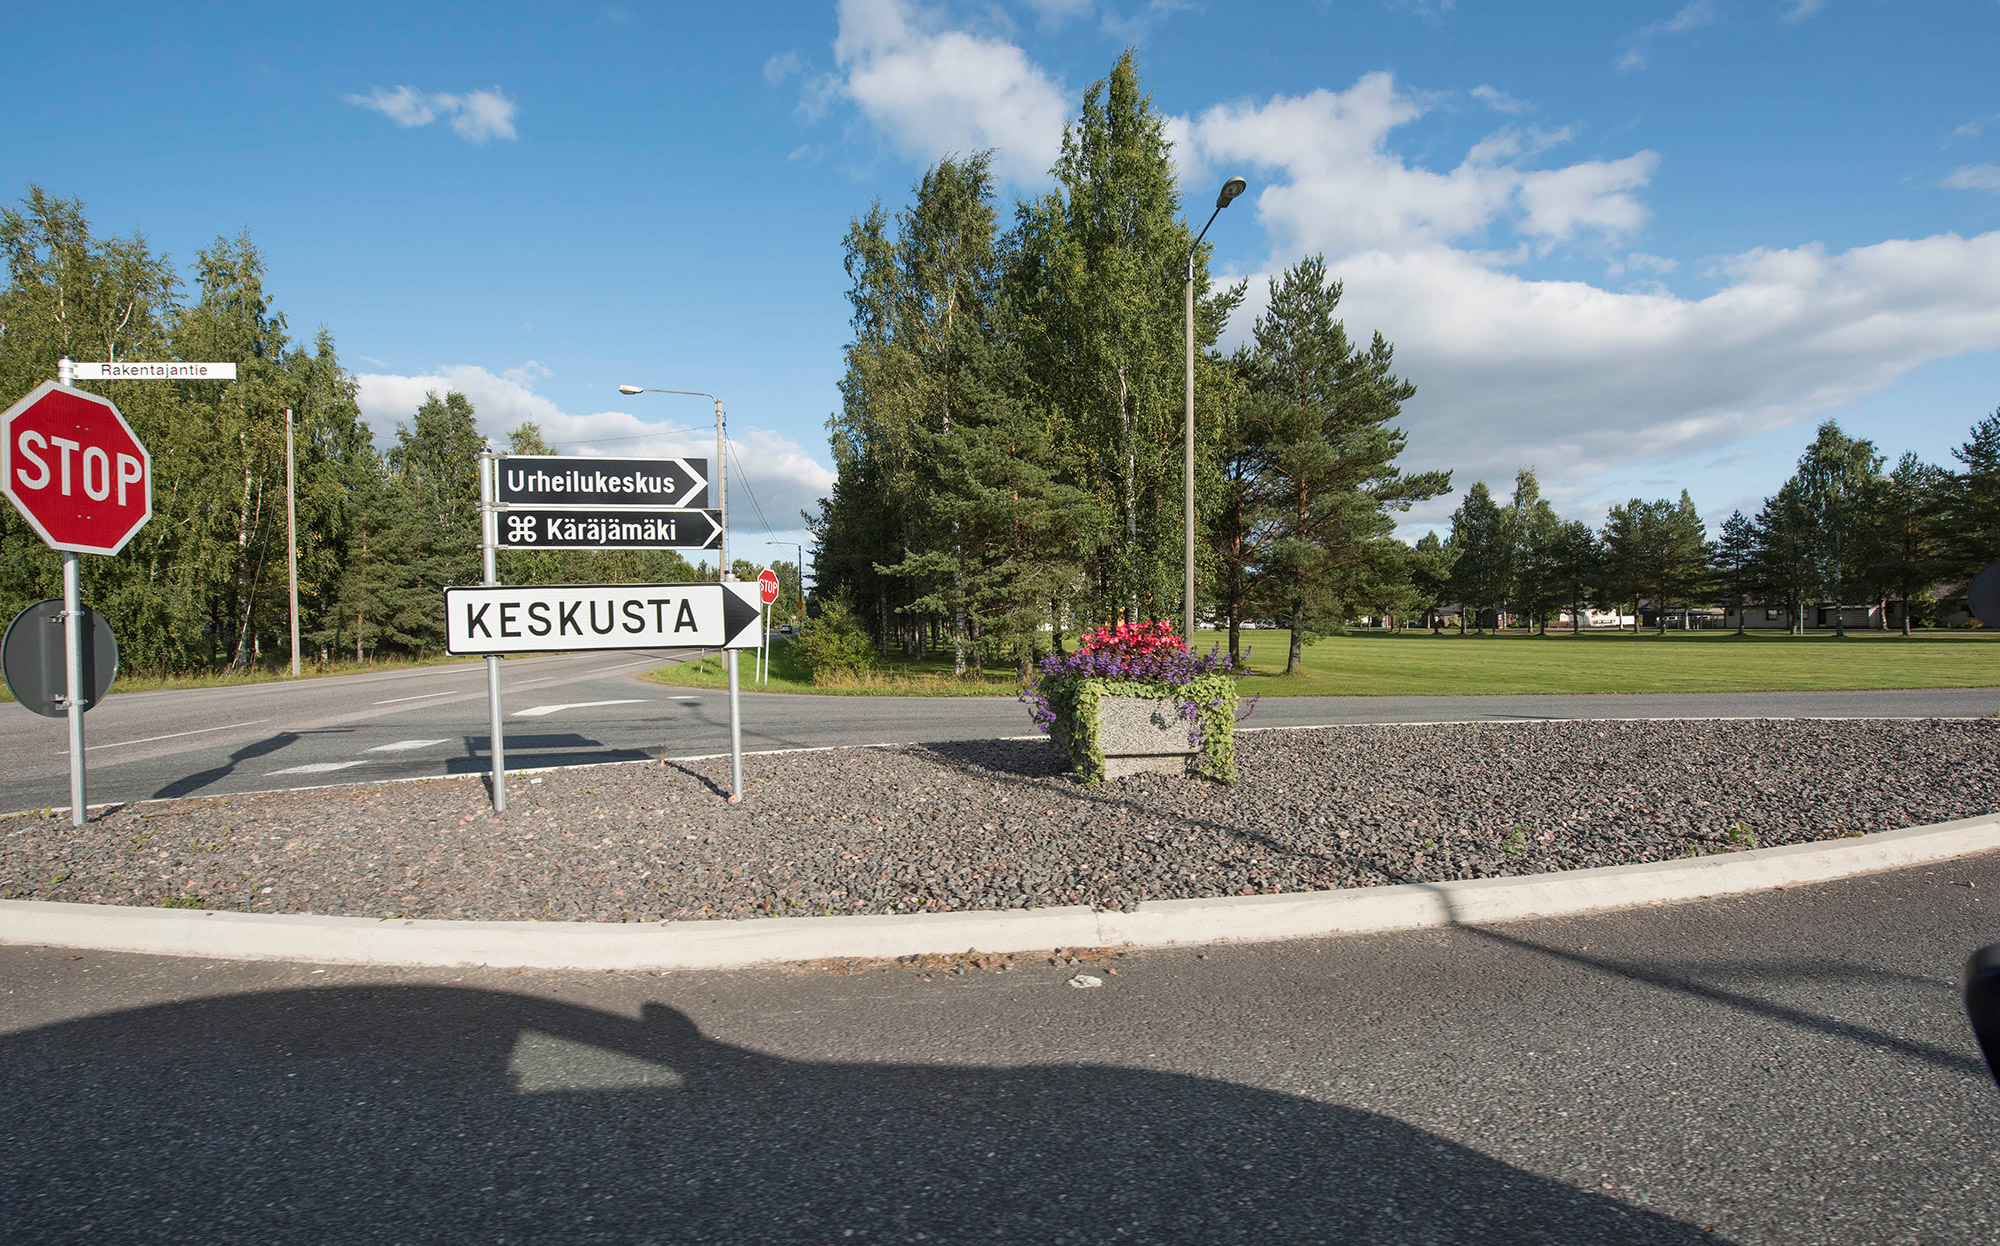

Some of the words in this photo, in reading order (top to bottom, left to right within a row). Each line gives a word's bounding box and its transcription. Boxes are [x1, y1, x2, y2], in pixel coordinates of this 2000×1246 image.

[101, 364, 208, 378] Rakentajantie
[17, 430, 143, 506] STOP
[507, 470, 675, 494] Urheilukeskus
[547, 518, 676, 544] Käräjämäki
[760, 579, 777, 594] STOP
[467, 599, 698, 638] KESKUSTA
